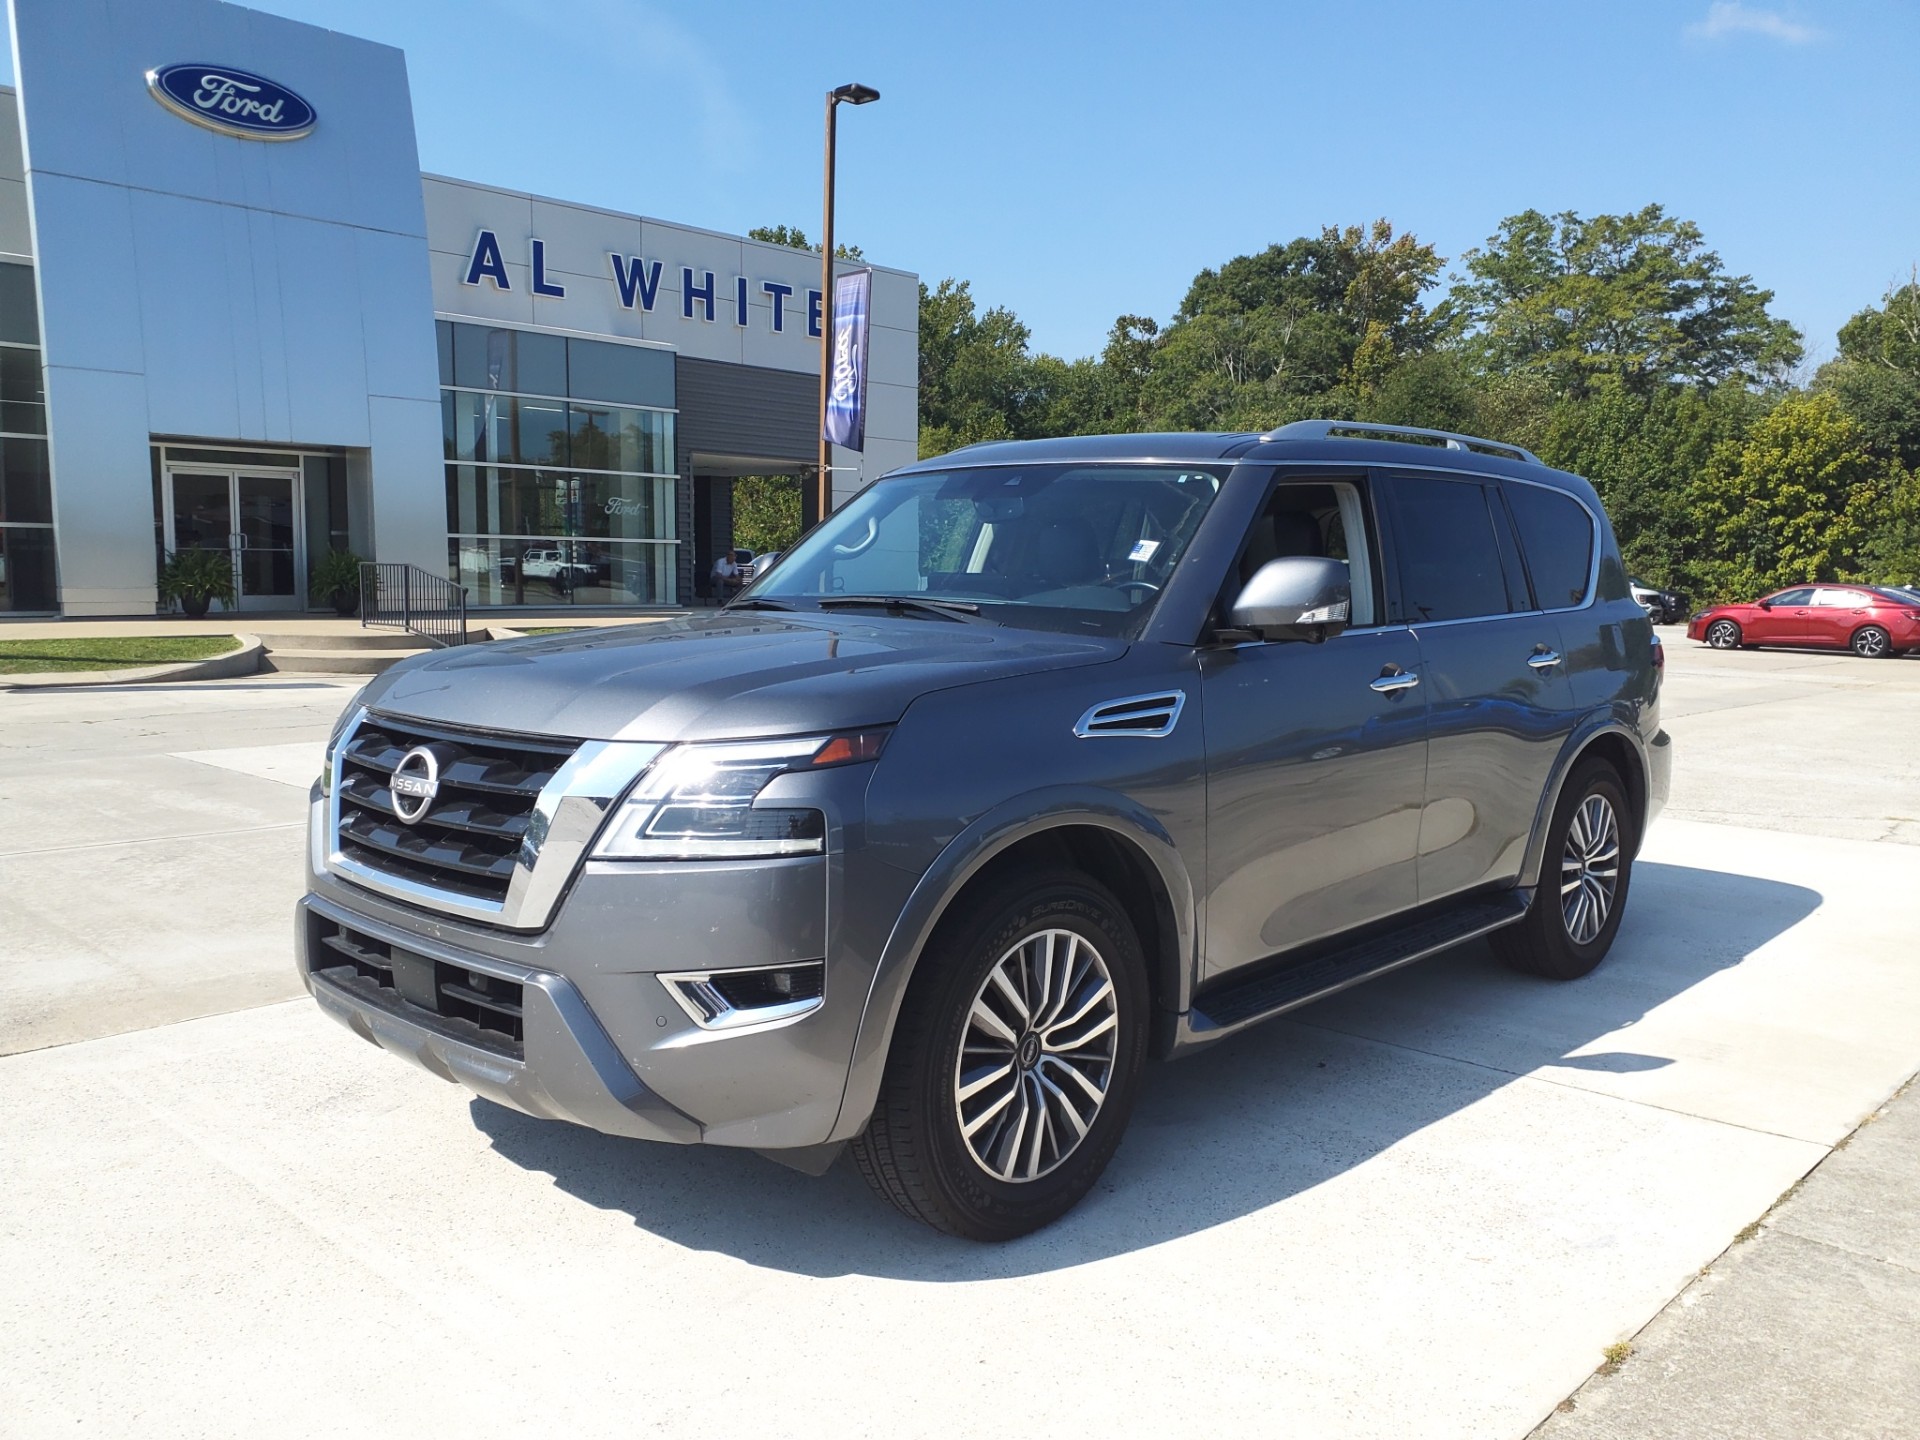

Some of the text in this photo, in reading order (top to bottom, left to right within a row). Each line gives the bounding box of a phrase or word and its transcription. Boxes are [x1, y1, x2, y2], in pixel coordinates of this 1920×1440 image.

[193, 74, 284, 124] Ford
[463, 229, 823, 338] AL WHITE
[604, 496, 641, 515] Ford
[390, 775, 436, 796] NISSAN
